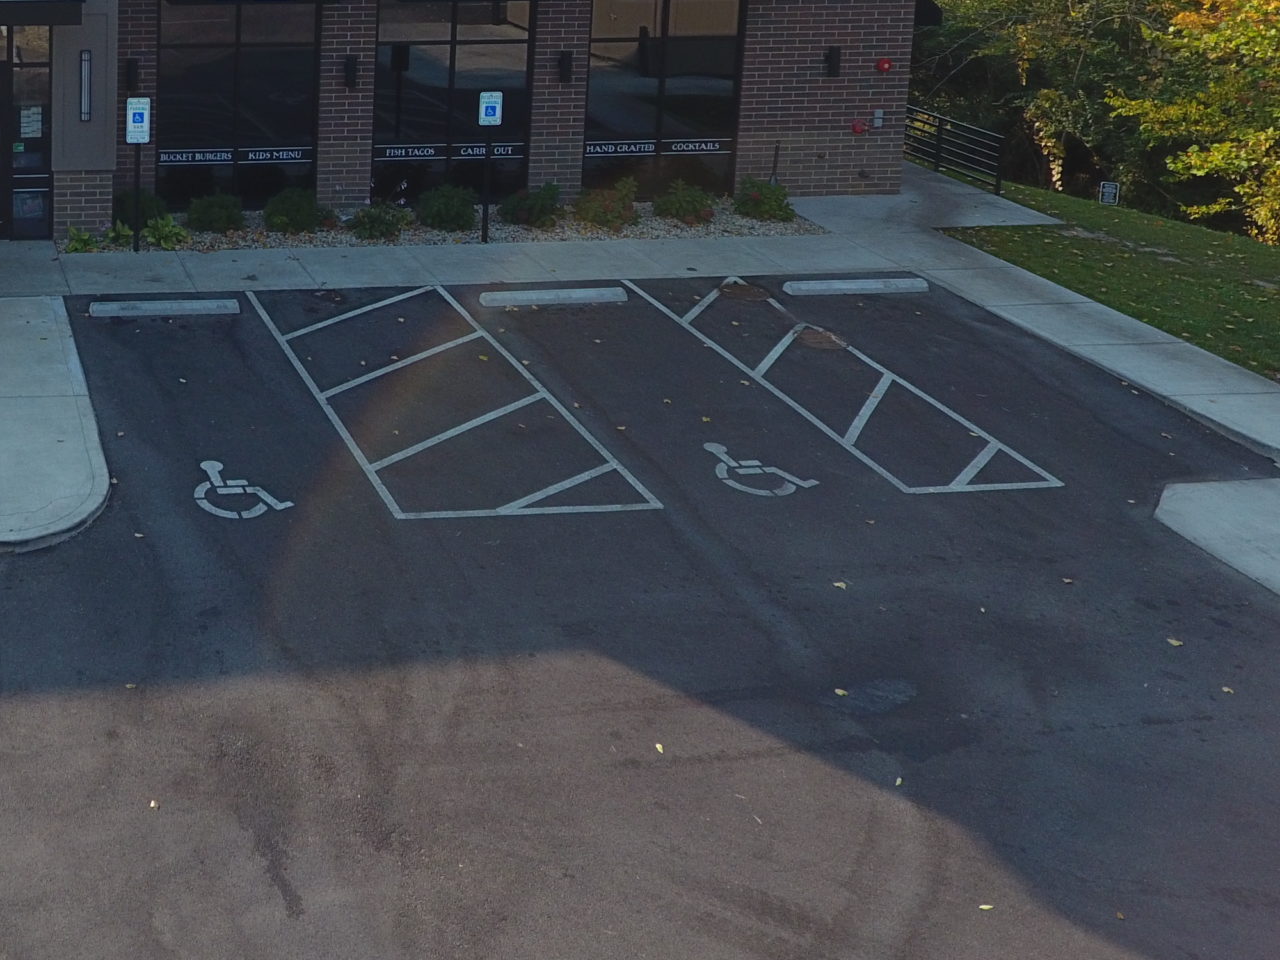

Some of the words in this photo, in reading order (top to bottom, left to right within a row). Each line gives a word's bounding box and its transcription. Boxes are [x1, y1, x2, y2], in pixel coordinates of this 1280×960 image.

[460, 147, 487, 155] CARR
[494, 146, 513, 155] OUT
[586, 144, 615, 153] HAND
[617, 143, 655, 152] CRAFTED
[671, 142, 720, 151] COCKTAILS
[248, 151, 271, 159] KIDS
[272, 150, 302, 159] MENU
[386, 148, 405, 156] FISH
[407, 147, 435, 156] TACOS
[160, 153, 193, 161] BUCKET
[195, 152, 232, 160] BURGERS
